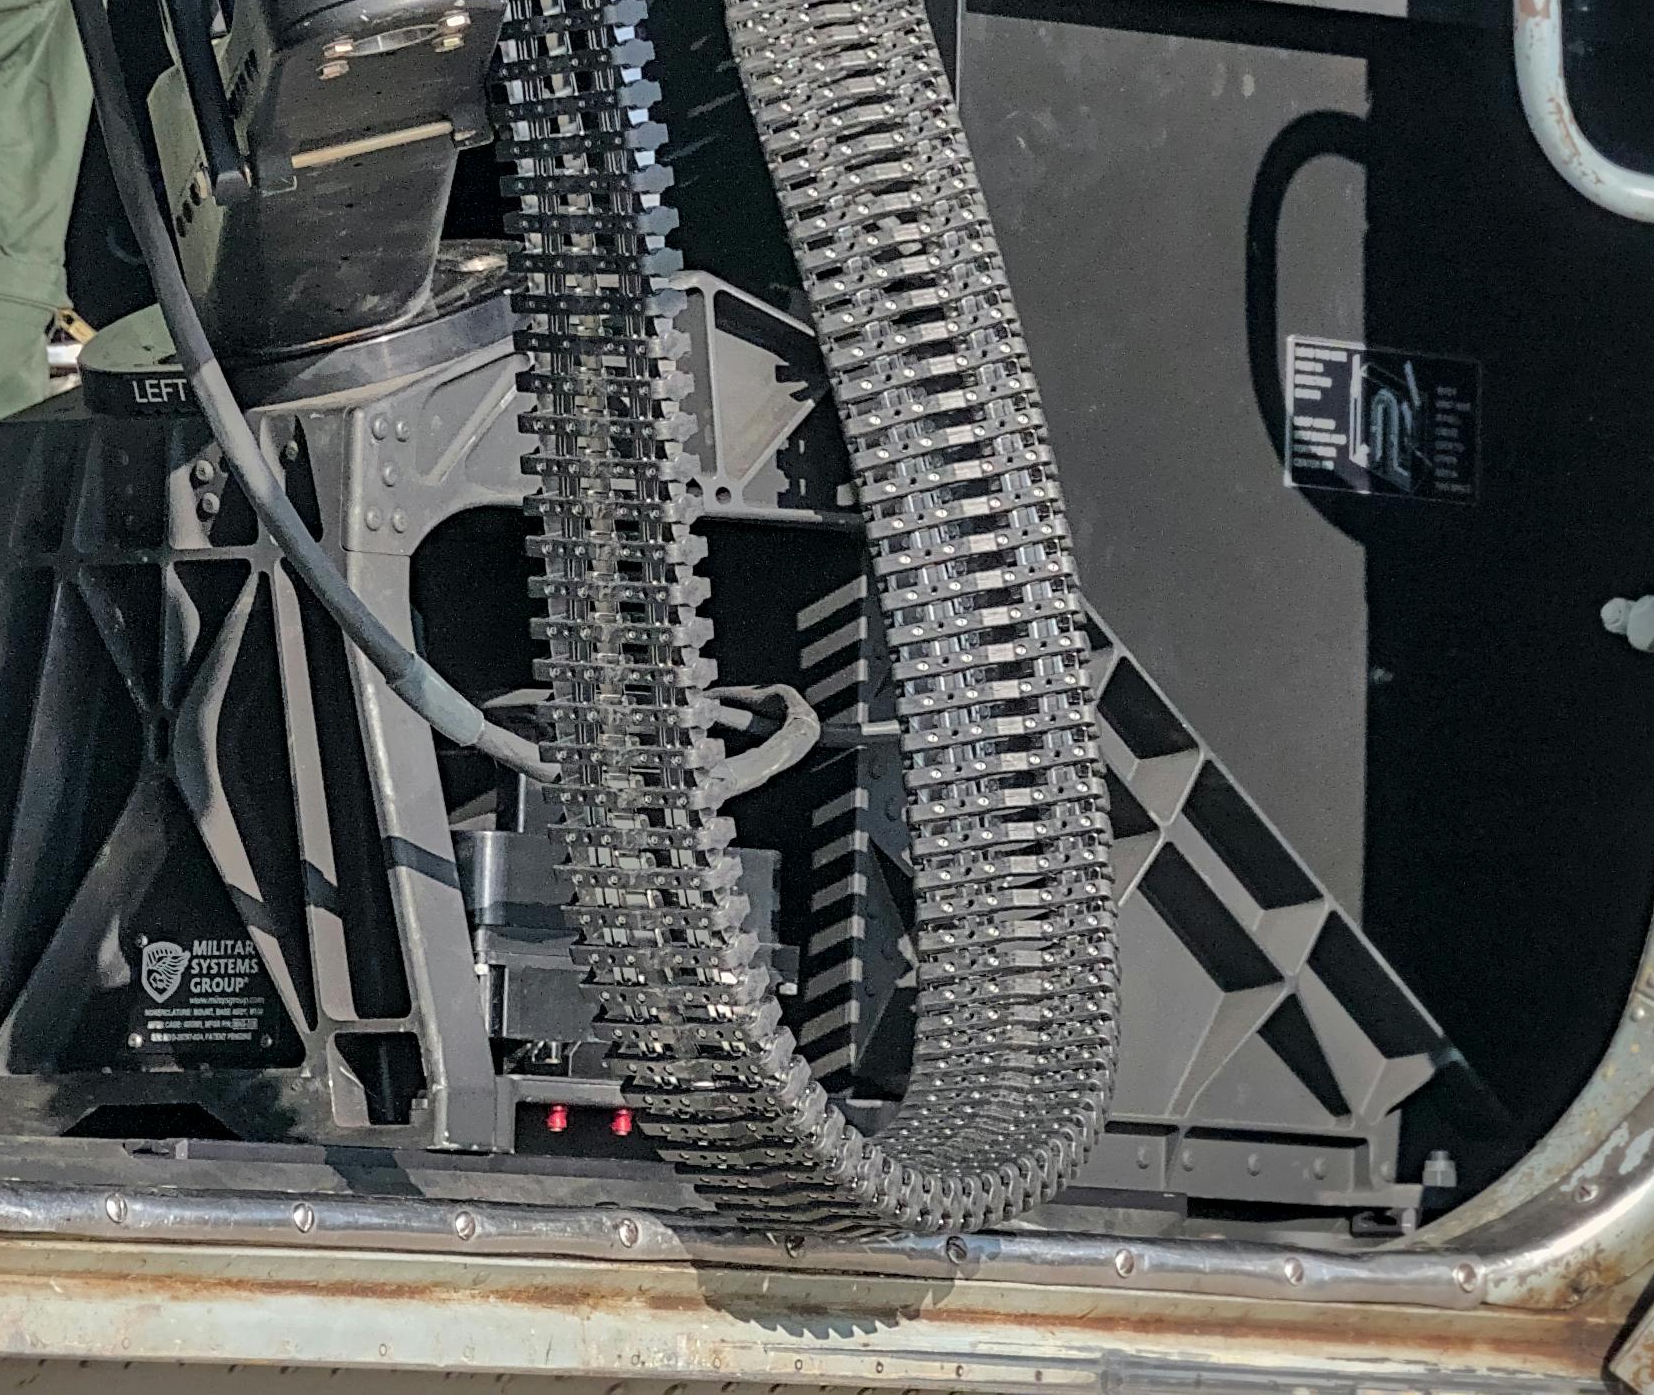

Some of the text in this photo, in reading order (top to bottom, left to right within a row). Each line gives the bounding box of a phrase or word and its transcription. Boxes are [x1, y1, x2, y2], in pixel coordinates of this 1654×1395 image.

[132, 378, 187, 403] LEFT
[192, 940, 256, 956] MILITAR
[190, 958, 260, 974] SYSTEMS
